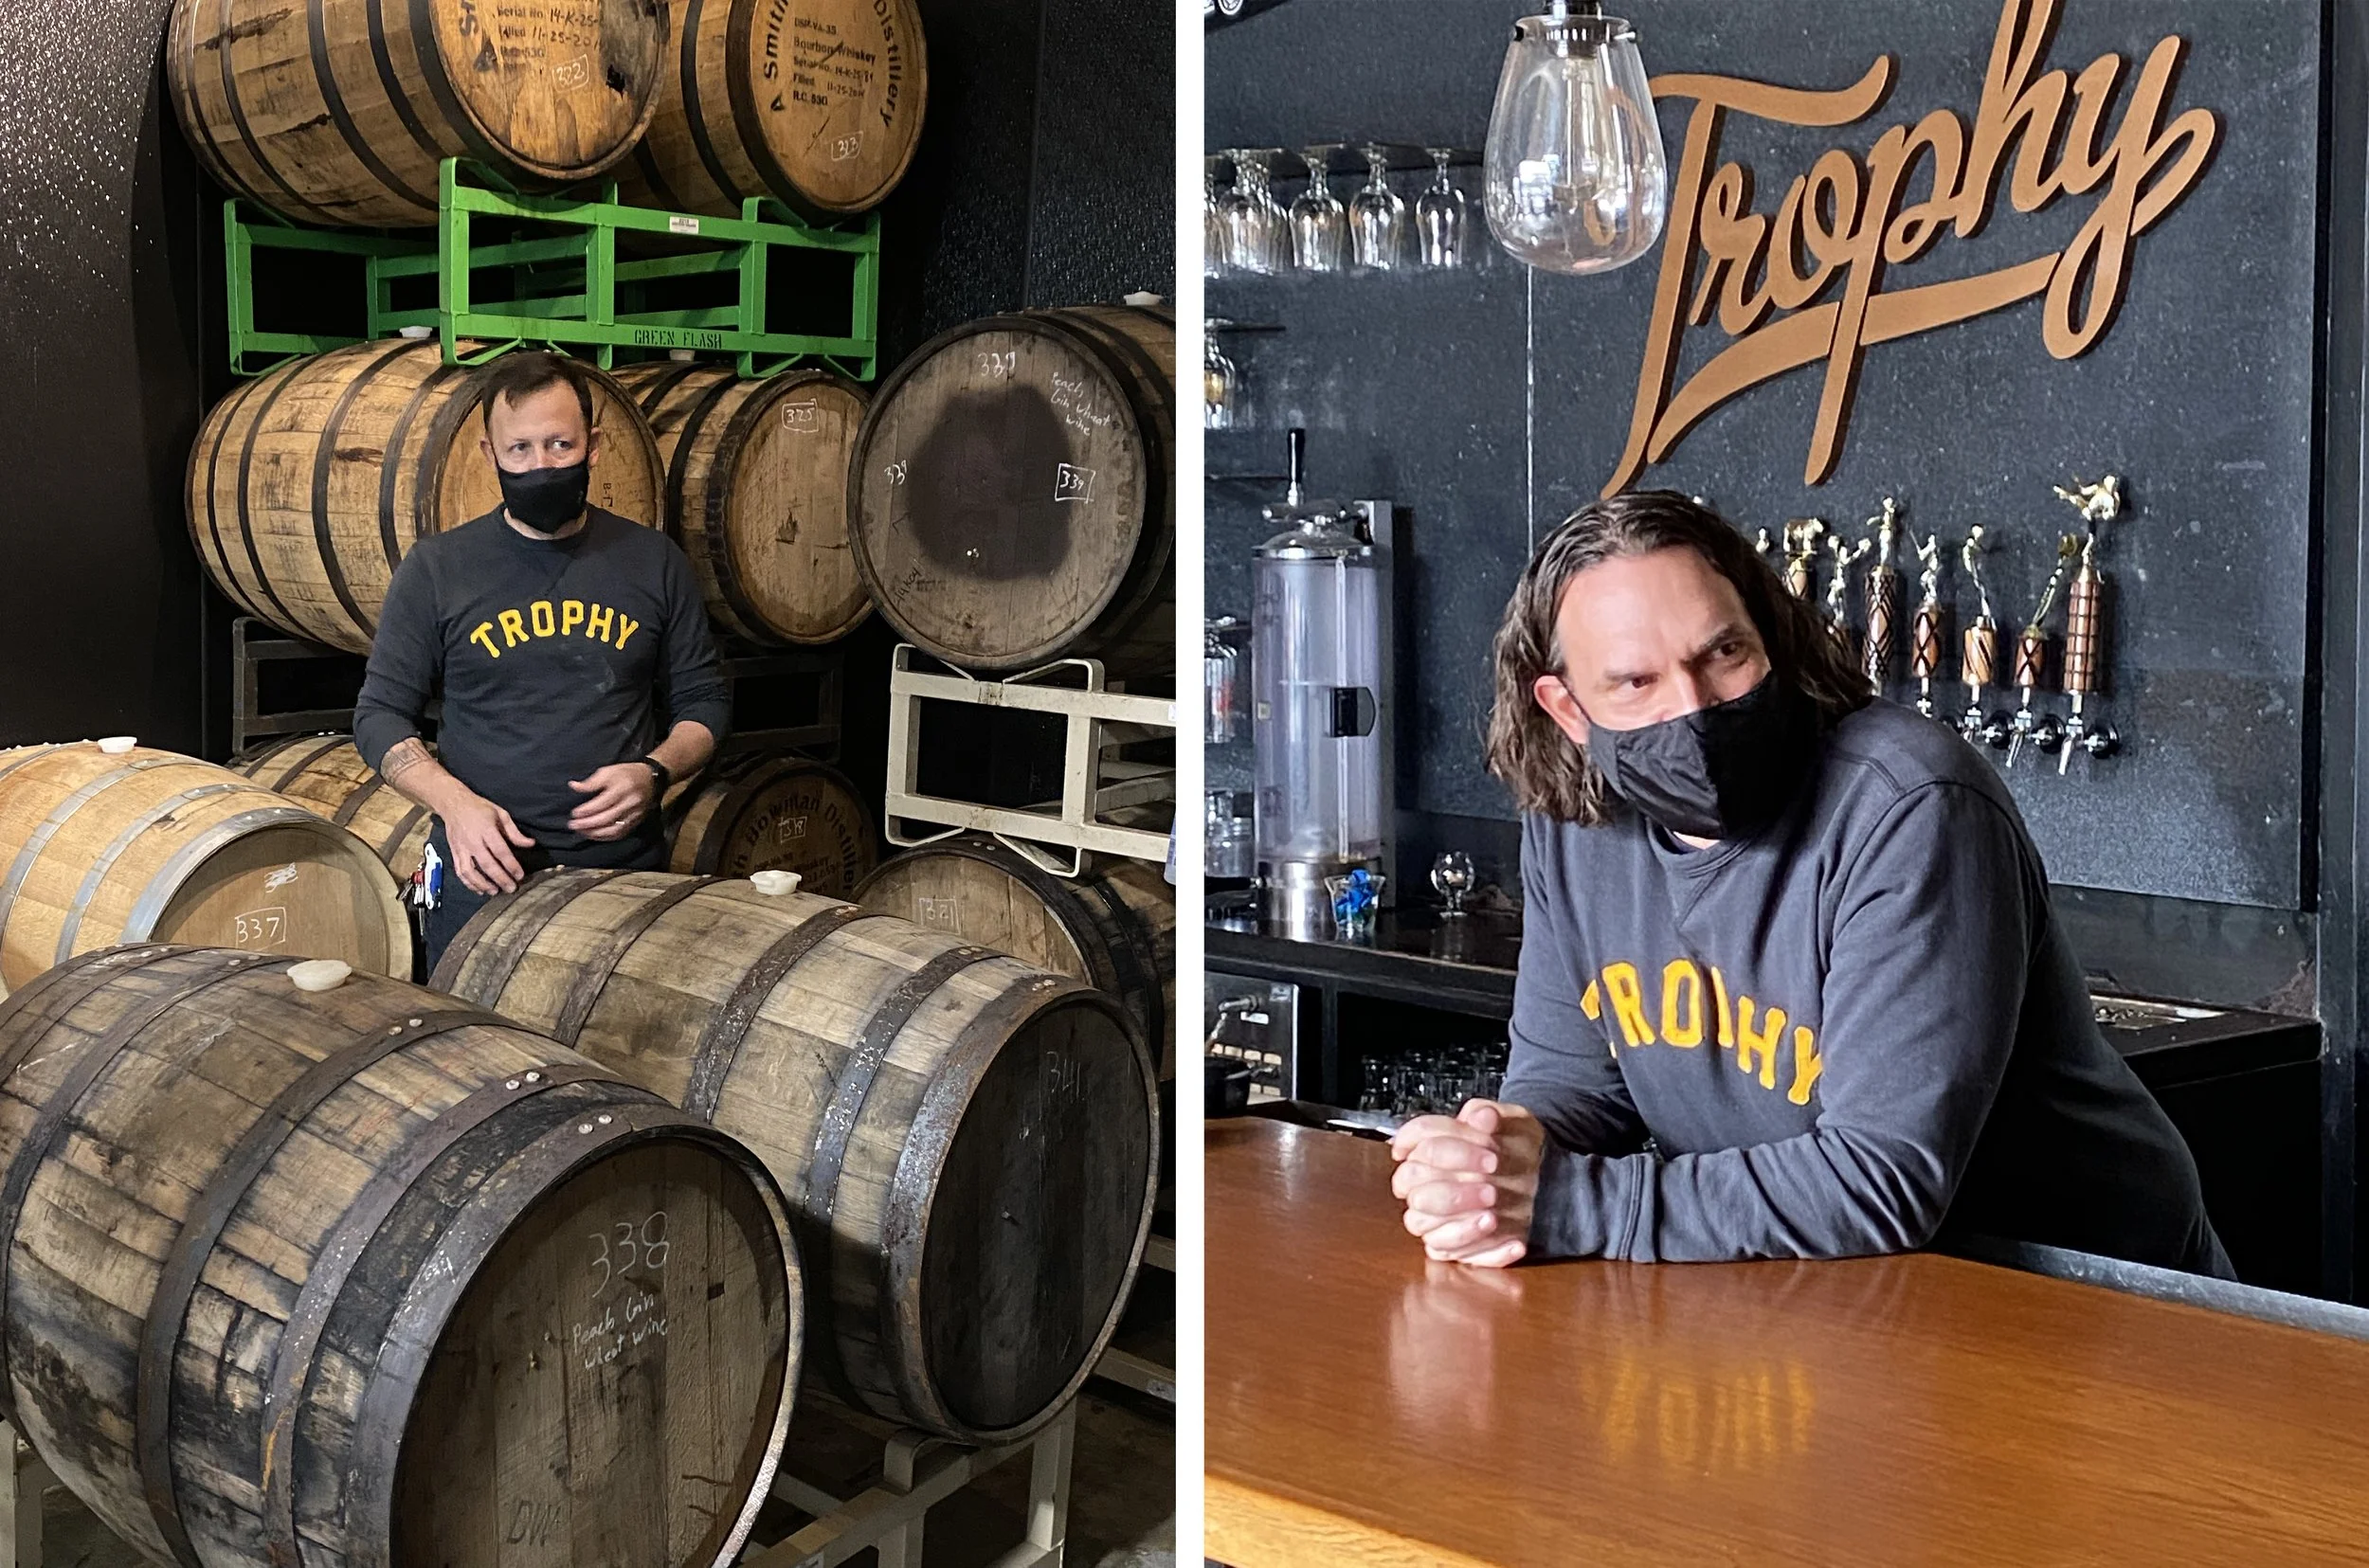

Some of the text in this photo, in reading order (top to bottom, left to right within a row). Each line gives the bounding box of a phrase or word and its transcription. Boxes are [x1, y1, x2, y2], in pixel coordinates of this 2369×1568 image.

[794, 37, 835, 55] Bourbon
[874, 0, 901, 128] Distillery
[1600, 0, 2215, 499] Trophy
[634, 329, 722, 350] GREEN FLASH
[977, 351, 1017, 379] 339
[787, 406, 814, 423] 325
[883, 460, 908, 485] 339
[1059, 470, 1085, 491] 339
[470, 600, 639, 658] TROPHY
[824, 802, 857, 891] Distiller
[236, 915, 280, 944] 337
[588, 1211, 670, 1298] 338
[572, 1307, 616, 1355] Peach
